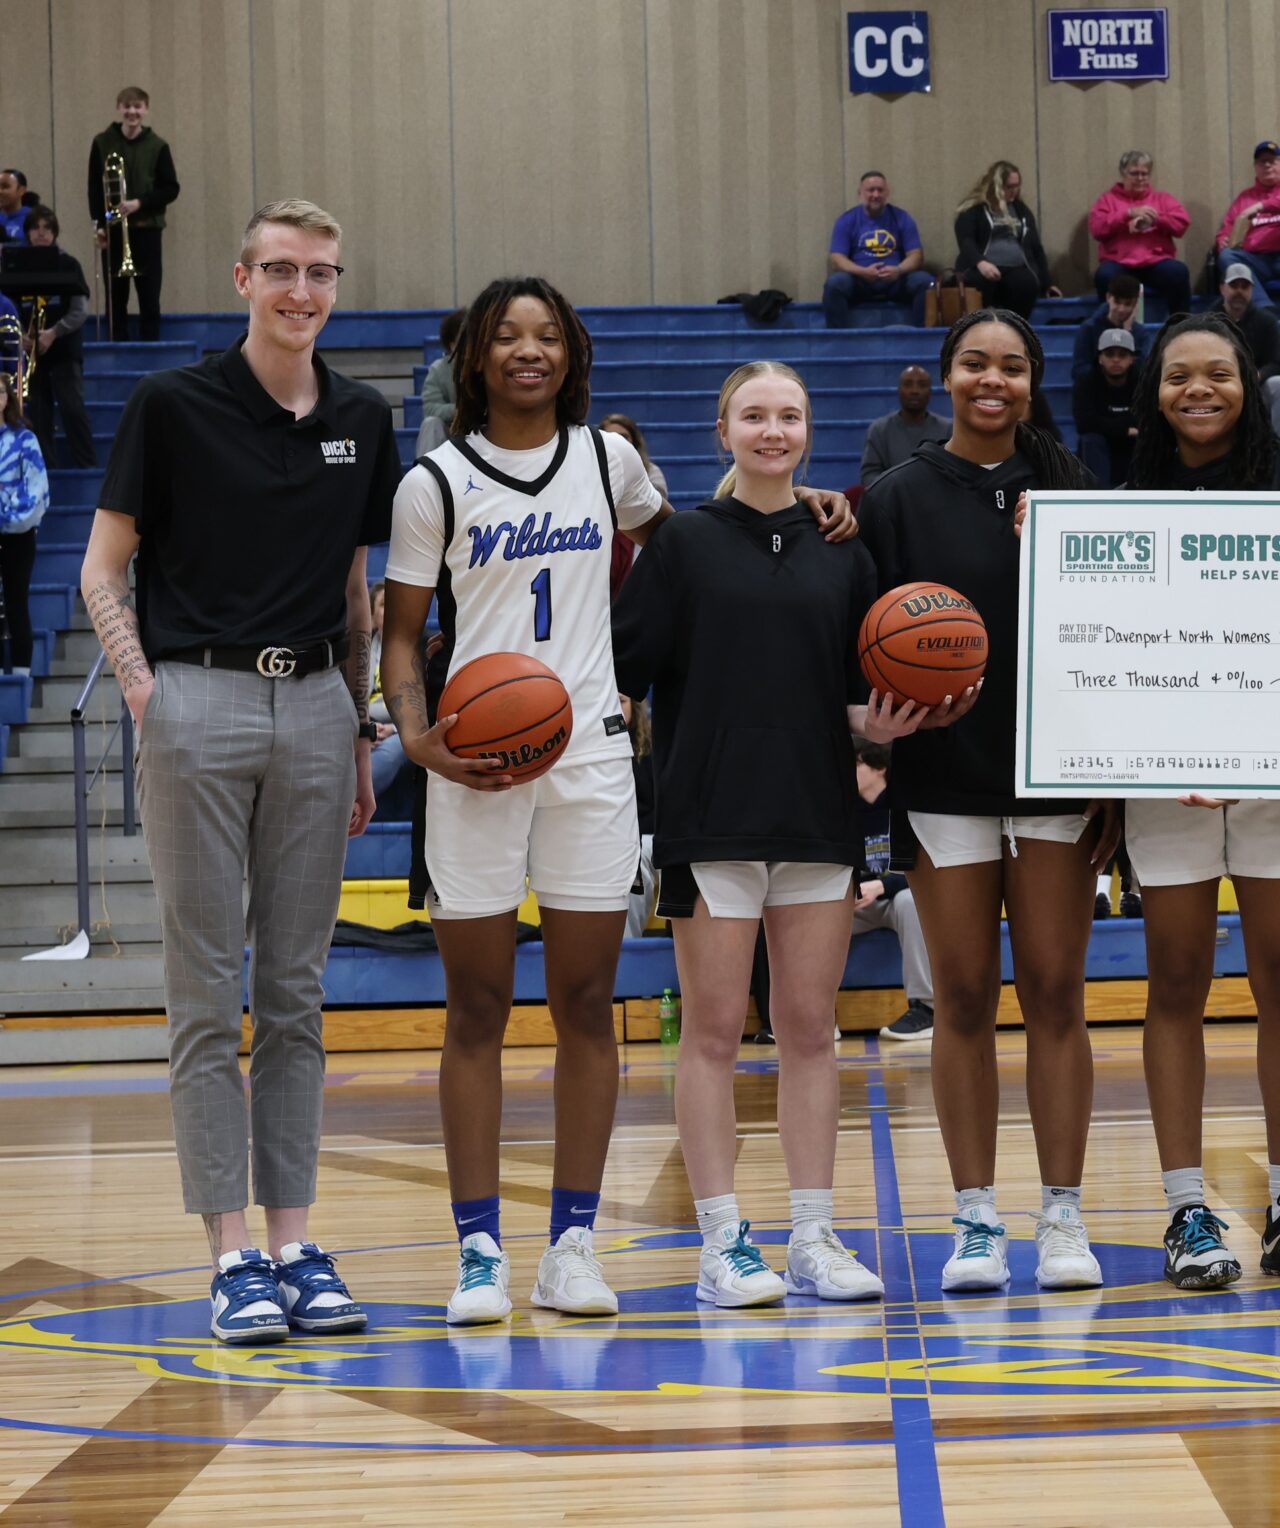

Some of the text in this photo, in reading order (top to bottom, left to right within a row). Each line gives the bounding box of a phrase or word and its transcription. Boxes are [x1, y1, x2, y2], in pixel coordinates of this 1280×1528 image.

[1062, 18, 1153, 47] NORTH
[853, 26, 925, 78] CC
[1079, 48, 1138, 70] Fans
[320, 438, 356, 456] DICK'S
[468, 512, 602, 569] Wildcats
[1065, 531, 1151, 562] DICK'S
[1059, 575, 1156, 583] FOUNDATION
[1200, 569, 1237, 580] HELP
[1242, 570, 1279, 580] SAVE
[531, 568, 552, 642] 1
[1059, 624, 1103, 633] PAY TO THE
[1059, 634, 1099, 643] ORDER OF
[1105, 626, 1172, 648] Davenport
[1179, 629, 1213, 643] North
[1223, 630, 1271, 644] Womens
[917, 636, 984, 649] EVOLUTION
[1067, 670, 1118, 688] Three
[1125, 670, 1200, 688] Thousand
